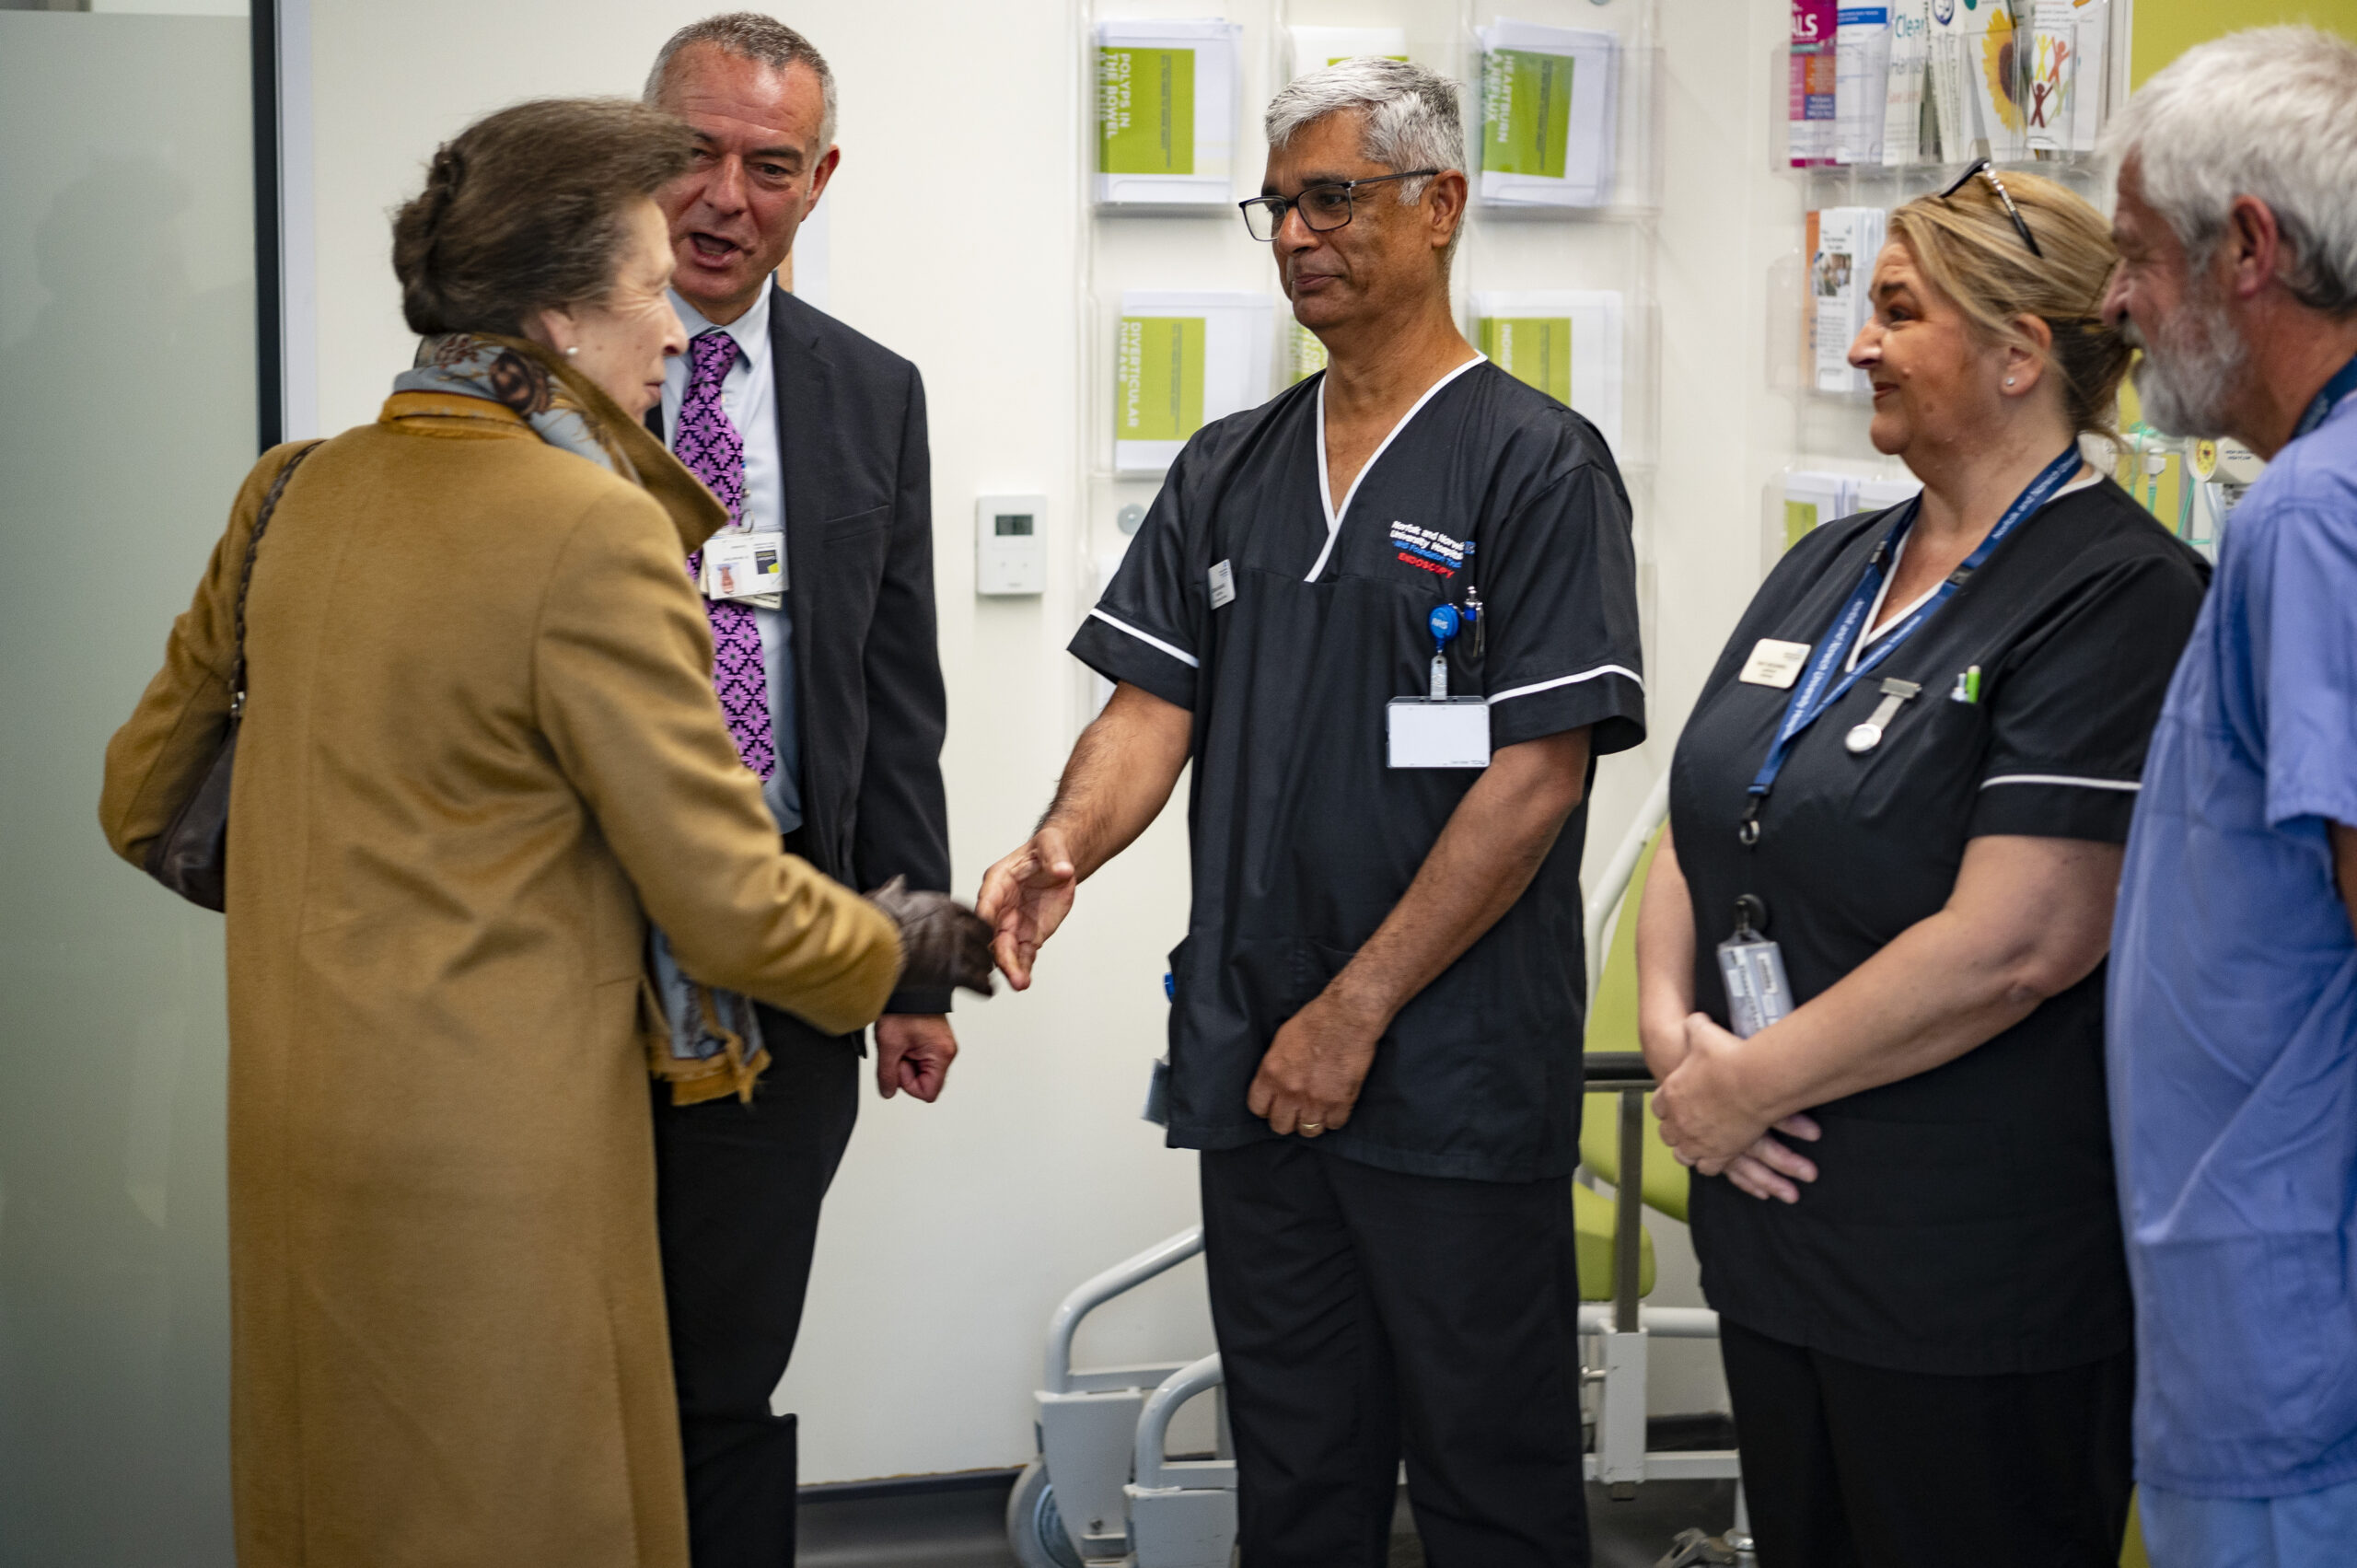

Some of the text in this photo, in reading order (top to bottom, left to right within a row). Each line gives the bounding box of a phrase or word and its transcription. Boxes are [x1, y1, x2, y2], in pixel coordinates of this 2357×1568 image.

[1106, 53, 1118, 139] THE BOWEL
[1120, 53, 1131, 128] POLYPS IN
[1497, 55, 1515, 143] HEARTBURN
[1128, 322, 1142, 427] DIVERTICULAR
[1398, 552, 1456, 579] ENDOSCOPY
